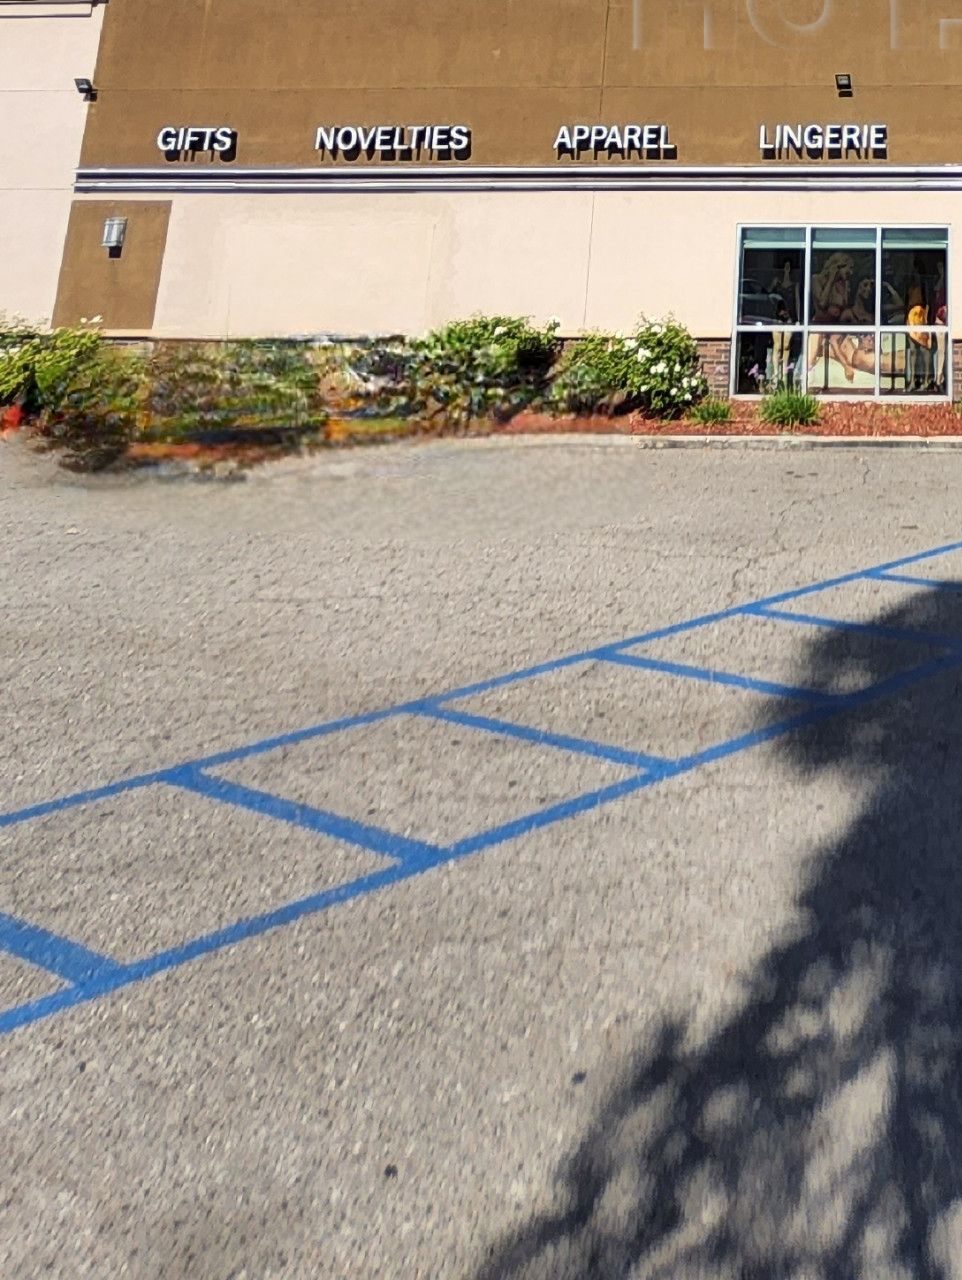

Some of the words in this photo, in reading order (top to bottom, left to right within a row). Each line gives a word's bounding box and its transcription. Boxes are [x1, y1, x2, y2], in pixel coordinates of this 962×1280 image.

[156, 126, 234, 152] GIFTS
[314, 125, 471, 151] NOVELTIES
[552, 124, 676, 150] APPAREL
[758, 123, 888, 150] LINGERIE
